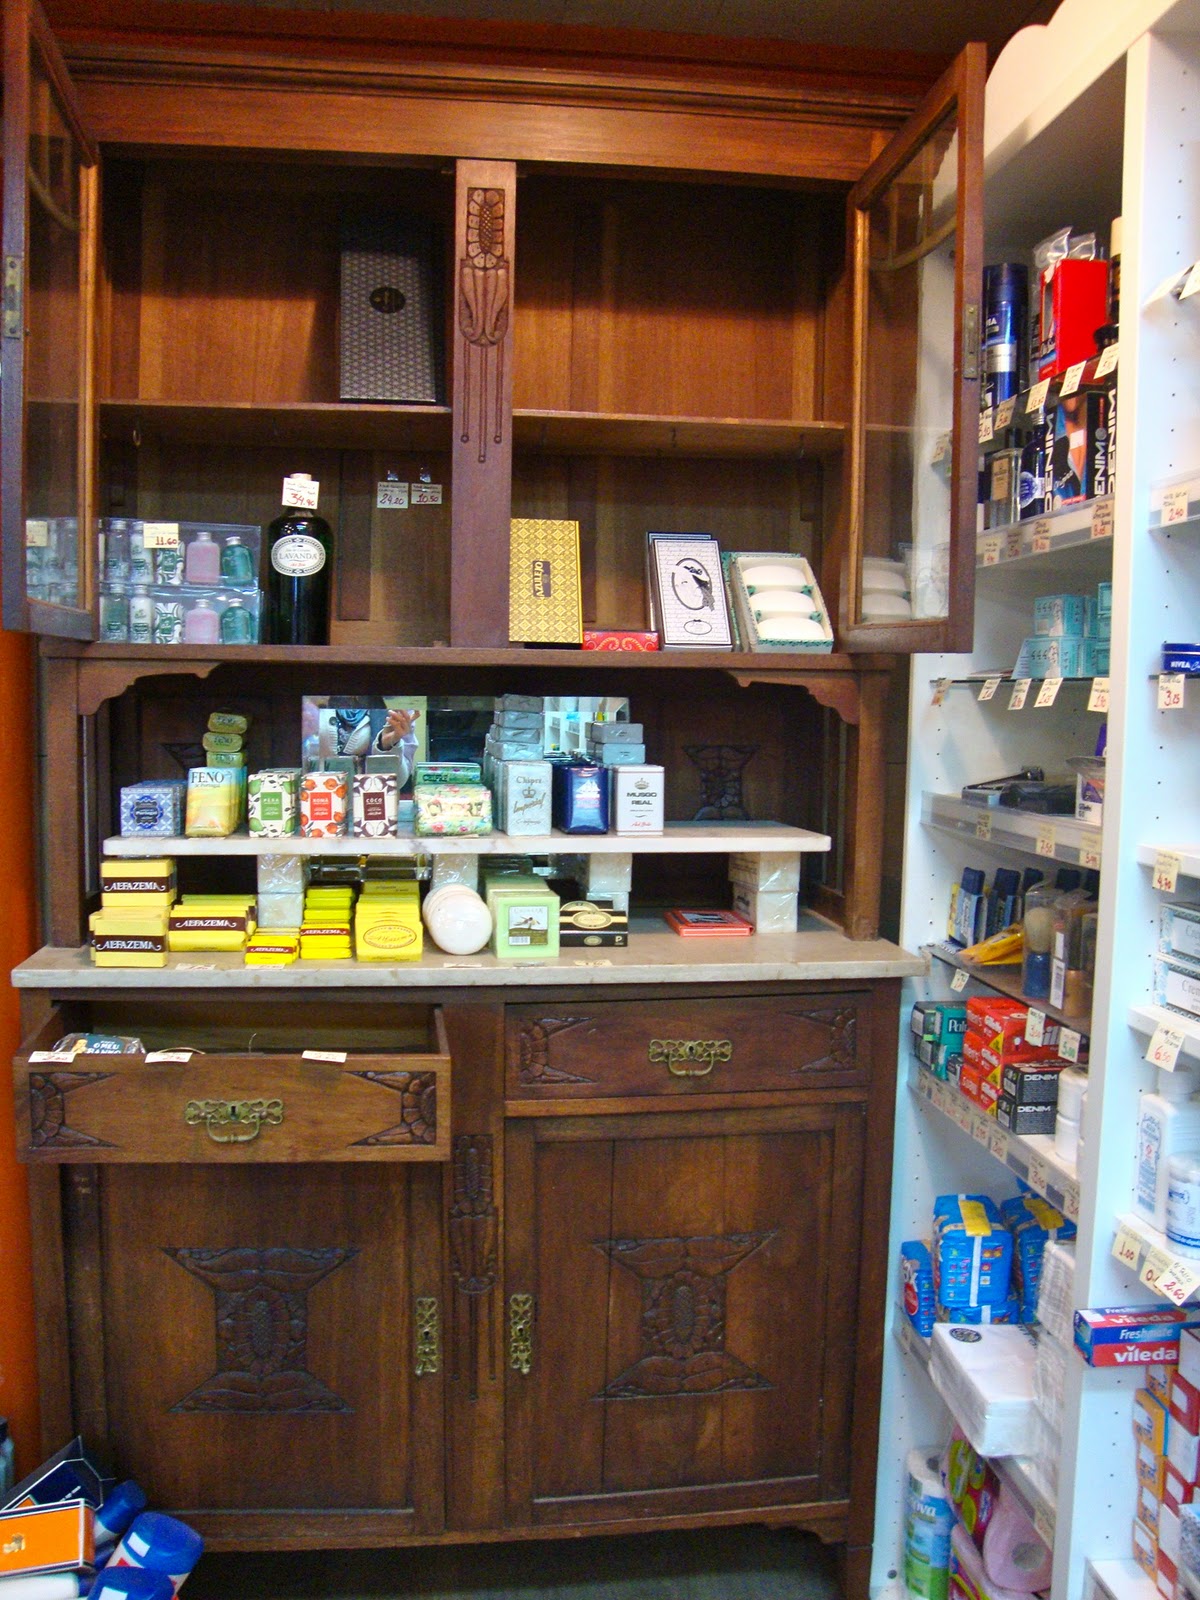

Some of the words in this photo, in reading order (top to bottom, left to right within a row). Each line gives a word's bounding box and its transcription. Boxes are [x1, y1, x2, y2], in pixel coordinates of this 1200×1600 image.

[1044, 413, 1055, 512] DENIM
[1094, 441, 1107, 498] ENIM
[155, 536, 178, 546] 11.60
[278, 551, 318, 561] LAVANDA
[534, 561, 545, 597] AZULEJO
[1170, 660, 1190, 669] NIVEA
[191, 771, 225, 784] FENO
[1017, 1105, 1051, 1113] DENIM
[1163, 1281, 1185, 1300] 2.60
[1119, 1327, 1174, 1340] Freshmate
[1114, 1345, 1178, 1363] vileda
